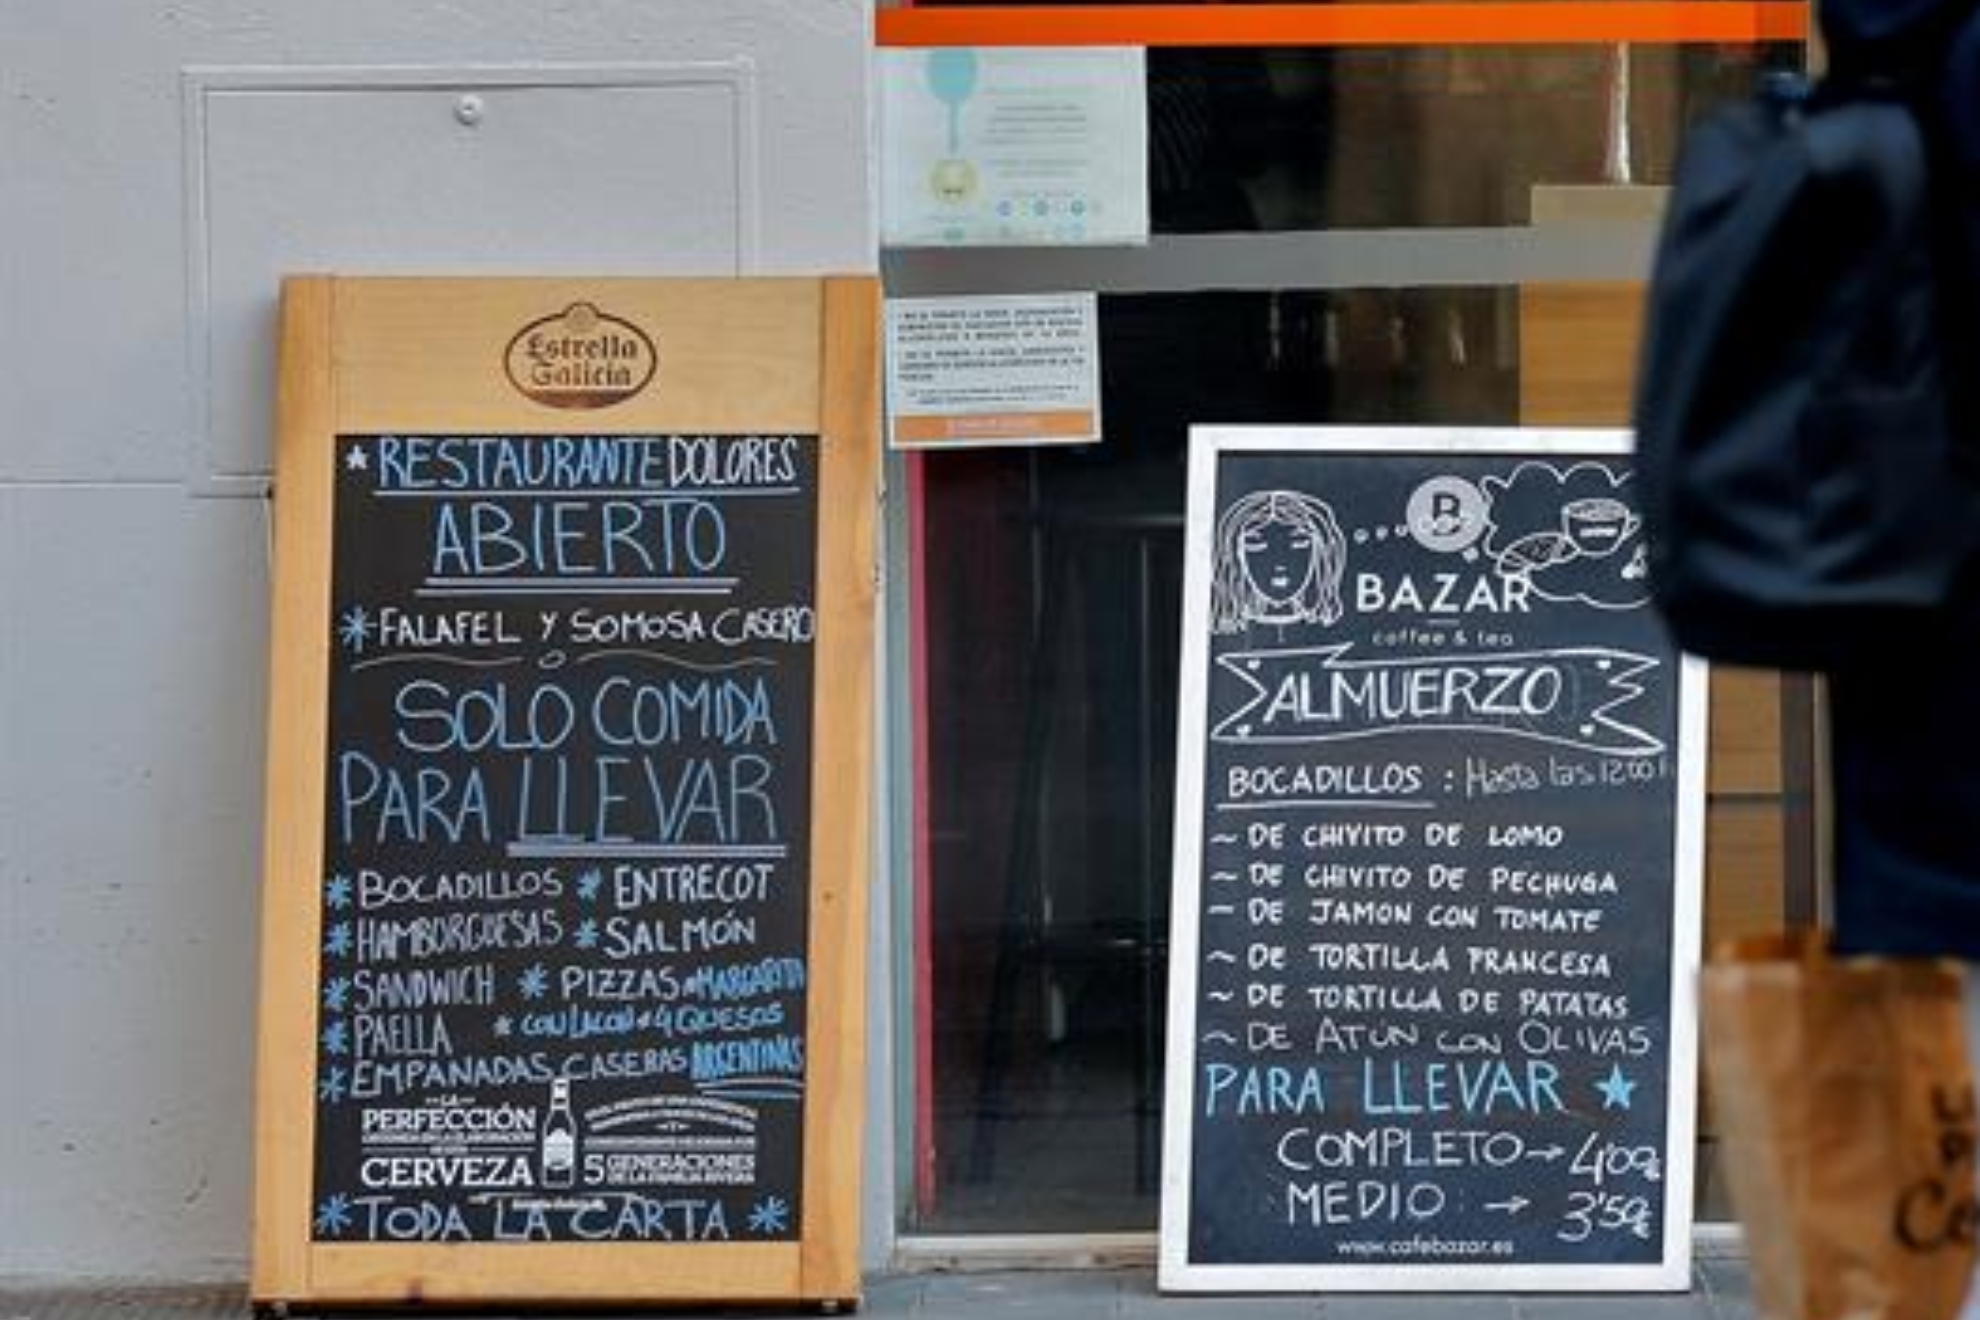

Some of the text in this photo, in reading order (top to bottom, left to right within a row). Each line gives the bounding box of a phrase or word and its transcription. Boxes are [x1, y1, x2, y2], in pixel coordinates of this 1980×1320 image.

[527, 332, 637, 359] Estrella
[532, 360, 631, 386] Galicia
[378, 436, 798, 489] RESTAURANTE DOLORES
[433, 501, 726, 575] ABIERTO
[1356, 573, 1531, 612] BAZAR
[380, 607, 521, 645] FALAFEL
[570, 610, 706, 643] SOMOSA
[712, 607, 814, 644] CASERO
[1372, 629, 1514, 647] coffee & tea
[395, 676, 778, 752] SOLO COMIDA
[1263, 665, 1563, 724] ALMUERZO
[340, 750, 777, 843] PARA LLEVAR
[1228, 764, 1423, 798] BOCADILLOS
[1466, 755, 1541, 800] Hasta
[1549, 755, 1595, 786] las
[1248, 823, 1563, 849] DE CHIVITO DE LOMO
[358, 867, 563, 909] BOCADILLOS
[614, 864, 774, 910] ENTRECOT
[1248, 862, 1618, 899] DE CHIVITO DE PECHUGA
[604, 908, 756, 959] SALMÓN
[1247, 897, 1602, 932] DE JAMON CON TOMATE
[1247, 942, 1611, 977] DE TORTILLA FRANCESA
[353, 963, 496, 1012] SANDWICH
[561, 965, 679, 1000] PIZZAS
[1247, 984, 1628, 1018] DE TORTILLA DE PATATAS
[353, 1012, 452, 1057] PAELLA
[1247, 1021, 1292, 1052] DE
[1517, 1019, 1652, 1055] OLIVAS
[350, 1051, 554, 1098] EMPANADAS
[560, 1047, 688, 1080] CASERAS
[1204, 1056, 1569, 1116] PARA LLEVAR
[361, 1101, 537, 1130] PERFECCIÓN
[584, 1153, 604, 1185] 5
[1276, 1128, 1524, 1171] COMPLETO
[361, 1157, 534, 1187] CERVEZA
[353, 1193, 730, 1241] TODA LA CARTA
[1286, 1180, 1446, 1227] MEDIO
[1336, 1232, 1514, 1257] www.cafebazar.es
